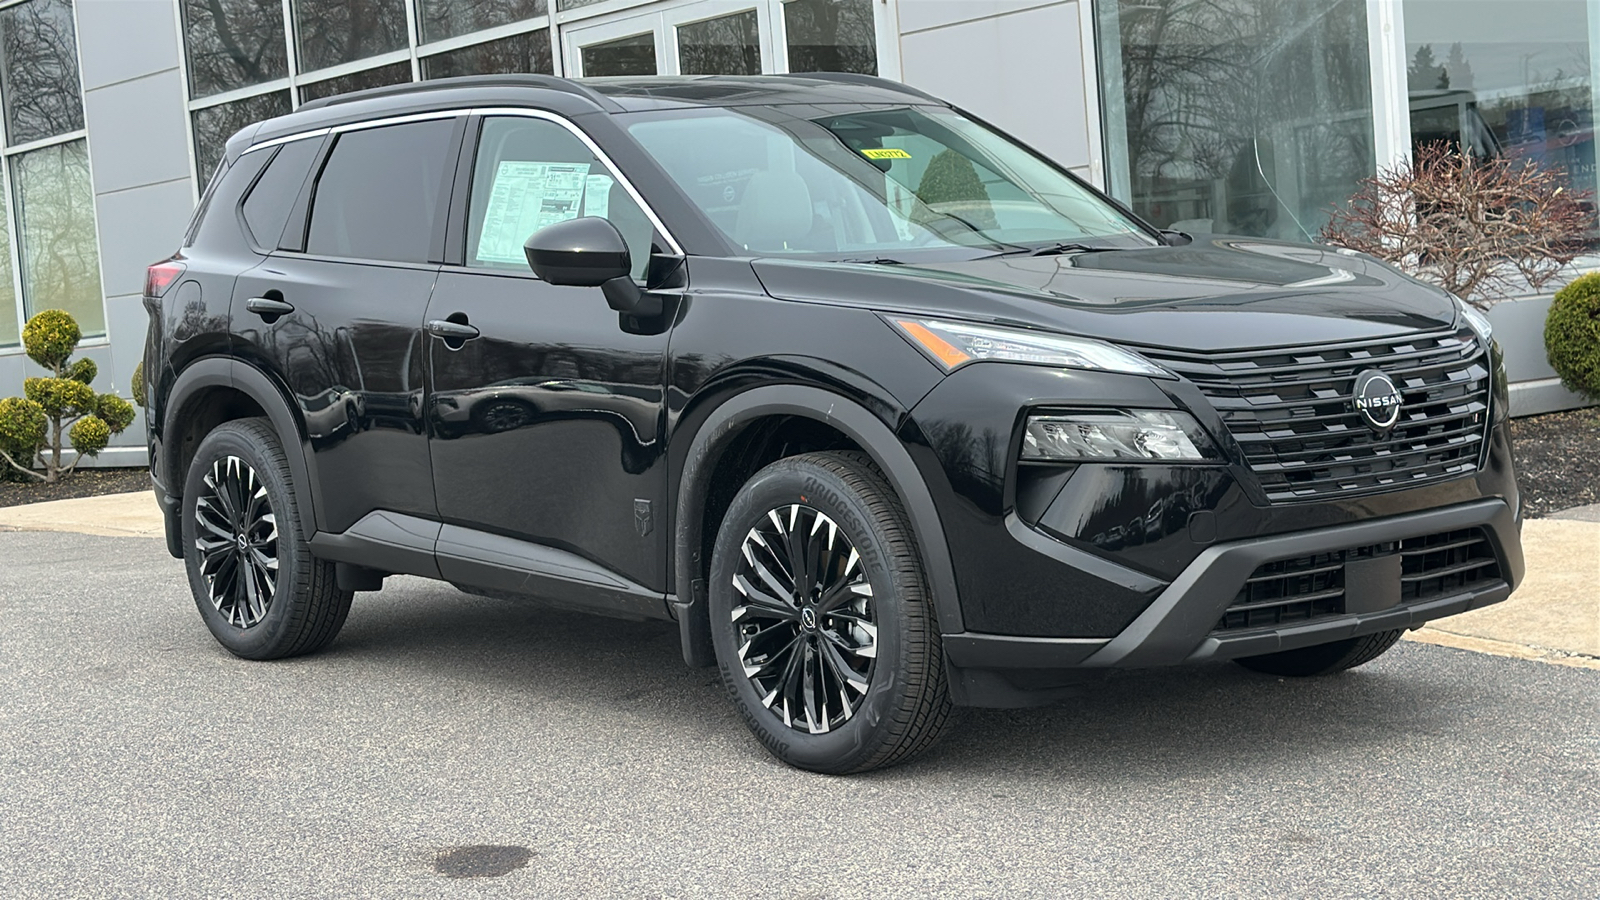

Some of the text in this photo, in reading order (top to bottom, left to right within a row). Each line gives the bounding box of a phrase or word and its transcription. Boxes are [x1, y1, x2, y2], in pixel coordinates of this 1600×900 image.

[1356, 395, 1402, 409] NISSAN
[803, 476, 884, 575] BRIDGESTONE
[720, 661, 791, 759] BRIDGESTONE
